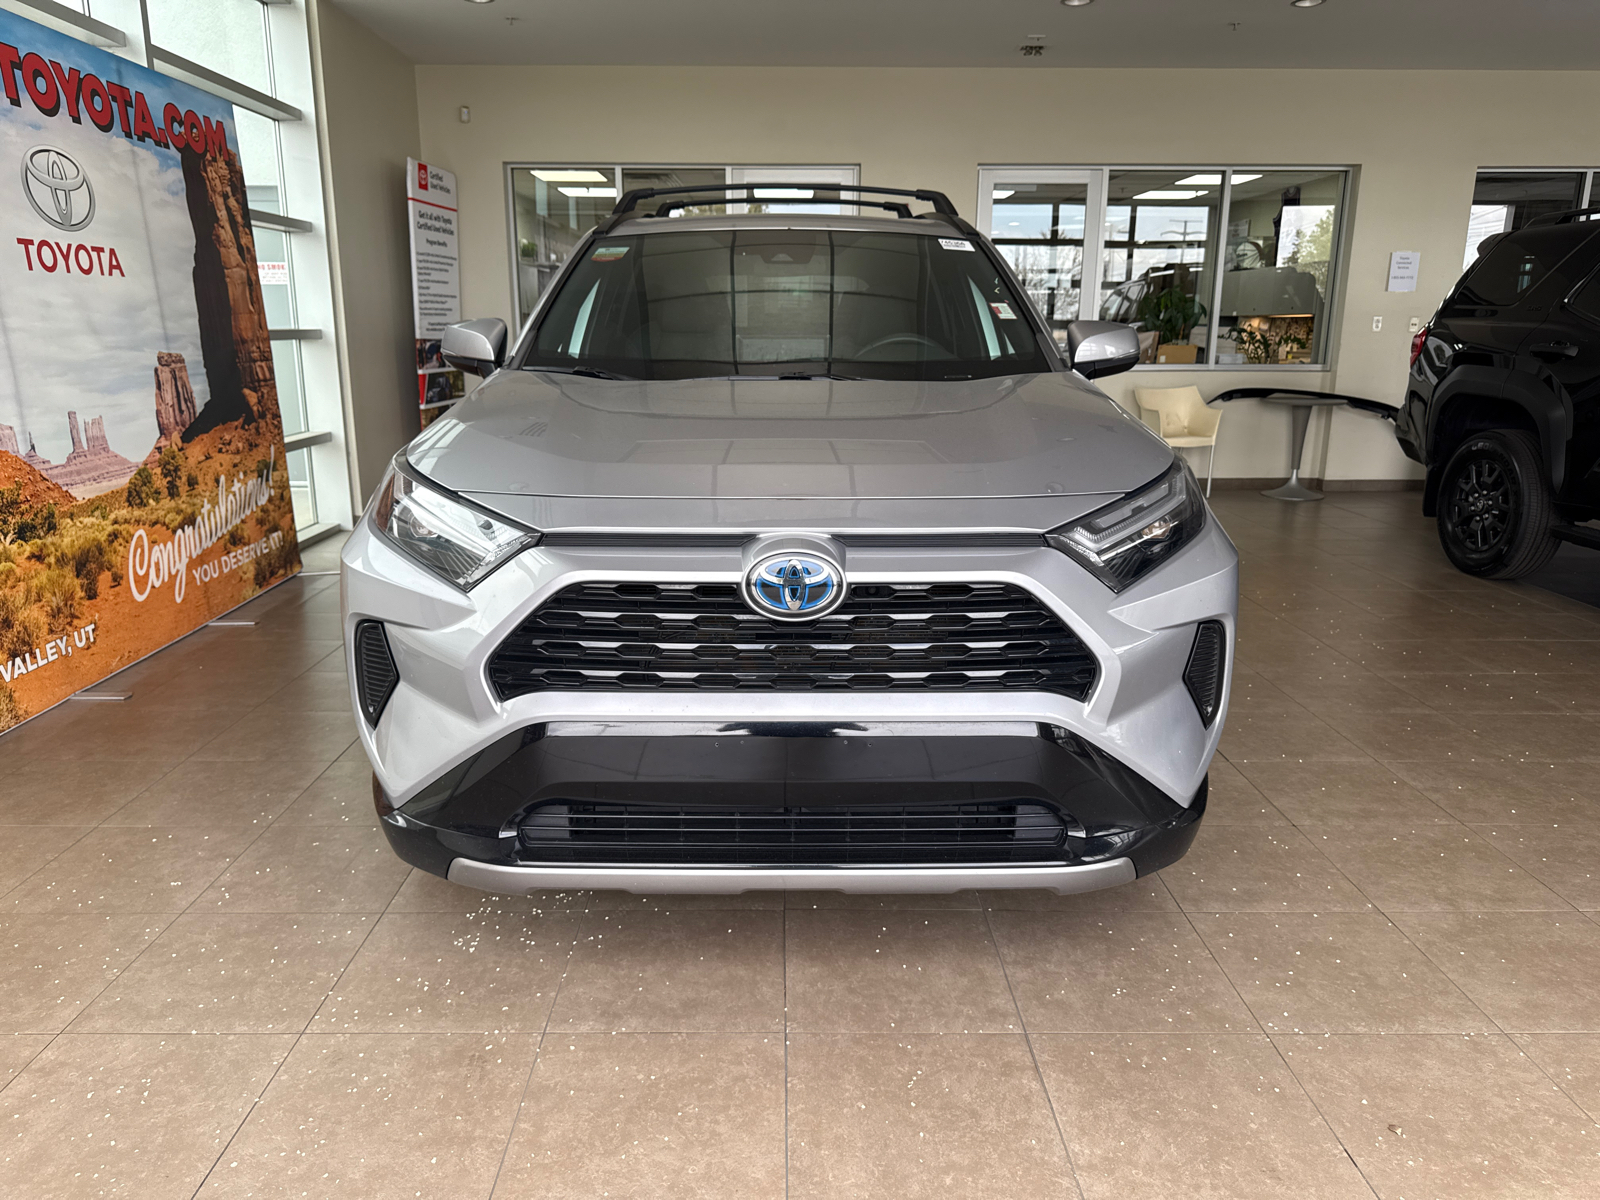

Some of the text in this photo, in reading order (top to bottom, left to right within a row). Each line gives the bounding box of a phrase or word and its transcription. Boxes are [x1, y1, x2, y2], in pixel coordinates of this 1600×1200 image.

[16, 237, 126, 278] TOYOTA
[128, 444, 275, 603] Congratulations!
[192, 530, 284, 586] YOU DESERVE IT!
[0, 623, 96, 683] VALLEY, UT
